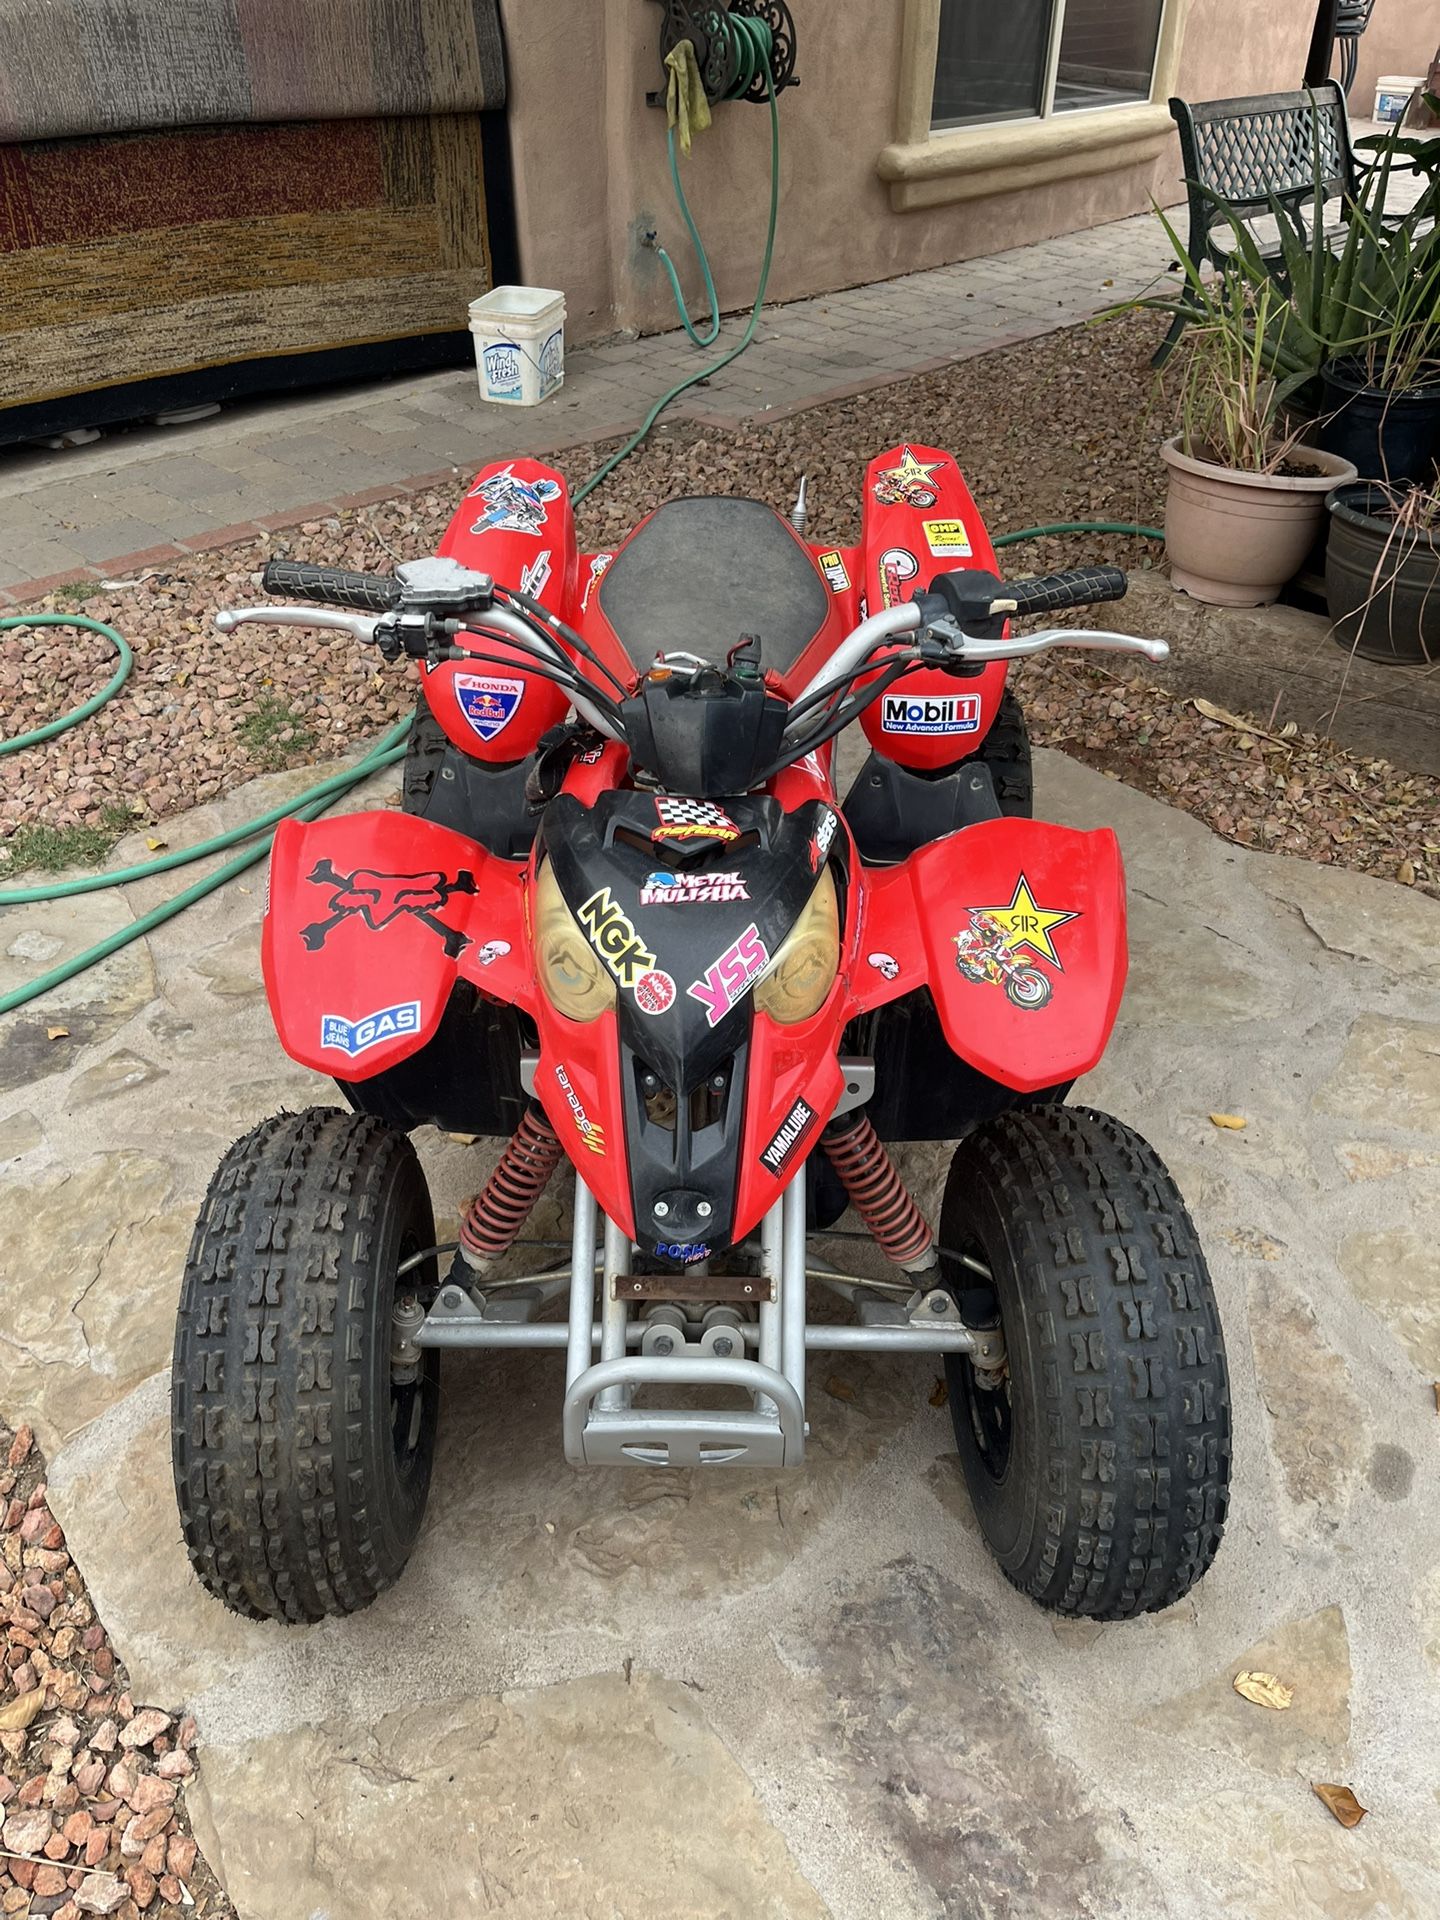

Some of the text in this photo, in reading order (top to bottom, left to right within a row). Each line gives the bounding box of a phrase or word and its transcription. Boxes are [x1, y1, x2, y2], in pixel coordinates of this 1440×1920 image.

[486, 350, 513, 373] Wind
[929, 523, 960, 533] OMP
[821, 553, 840, 568] PRO
[472, 681, 518, 693] HONDA
[468, 705, 505, 719] Red Bull
[886, 700, 954, 722] Mobil
[886, 722, 974, 732] New Advanced Formula
[674, 872, 747, 888] METAL
[640, 884, 752, 905] MULISHA
[582, 893, 652, 982] NGK
[690, 926, 766, 1024] YSS
[647, 975, 670, 1001] NGK
[329, 1021, 348, 1036] BLUE
[356, 1008, 415, 1046] GAS
[325, 1032, 350, 1048] JEANS
[555, 1064, 593, 1136] tanabe
[763, 1102, 811, 1167] YAMALUBE
[655, 1242, 706, 1259] POSH
